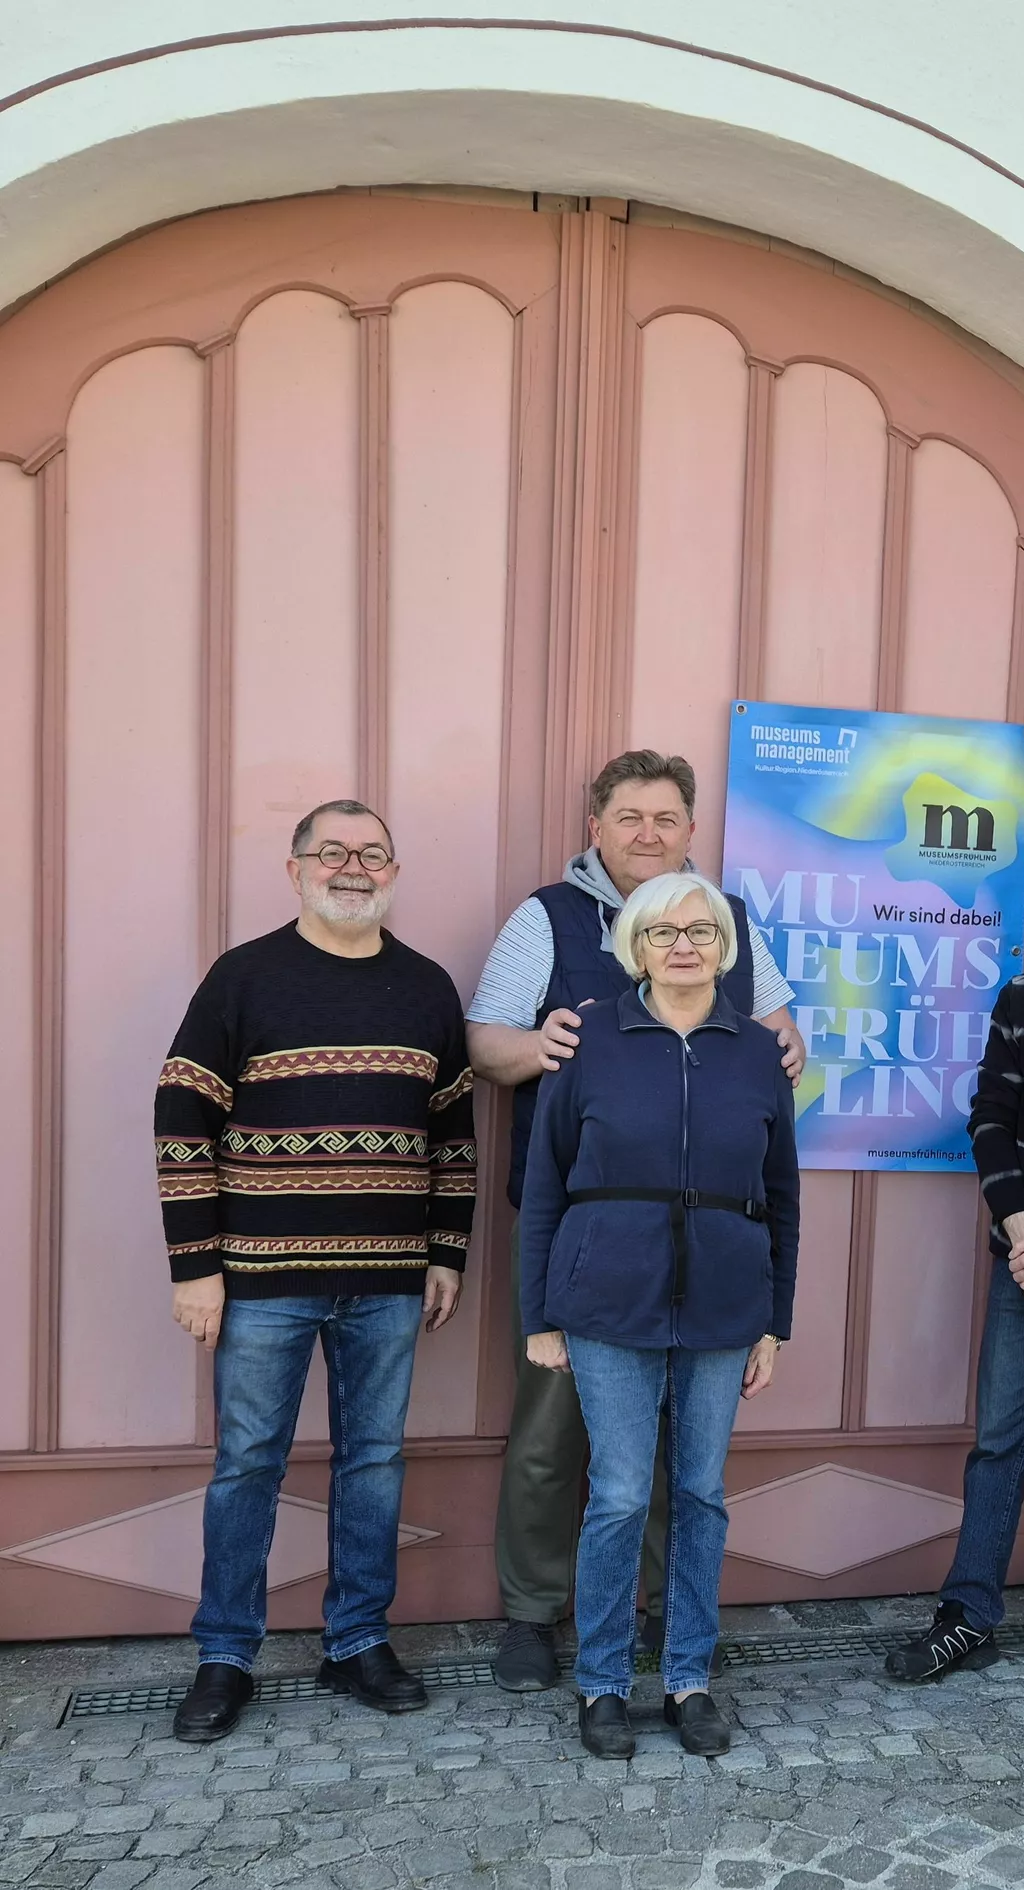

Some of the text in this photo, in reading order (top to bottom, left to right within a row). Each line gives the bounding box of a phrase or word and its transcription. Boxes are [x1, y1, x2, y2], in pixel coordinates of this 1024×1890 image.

[751, 725, 821, 745] museums
[755, 743, 850, 765] management
[919, 803, 997, 852] m
[918, 850, 997, 862] MUSEUMSFRÜHLING
[735, 868, 866, 928] MU
[873, 904, 1002, 927] Wir sind dabei!
[756, 925, 1001, 990] EUMS
[791, 995, 991, 1062] FRÜH
[867, 1148, 967, 1162] museumsfrühling.at
